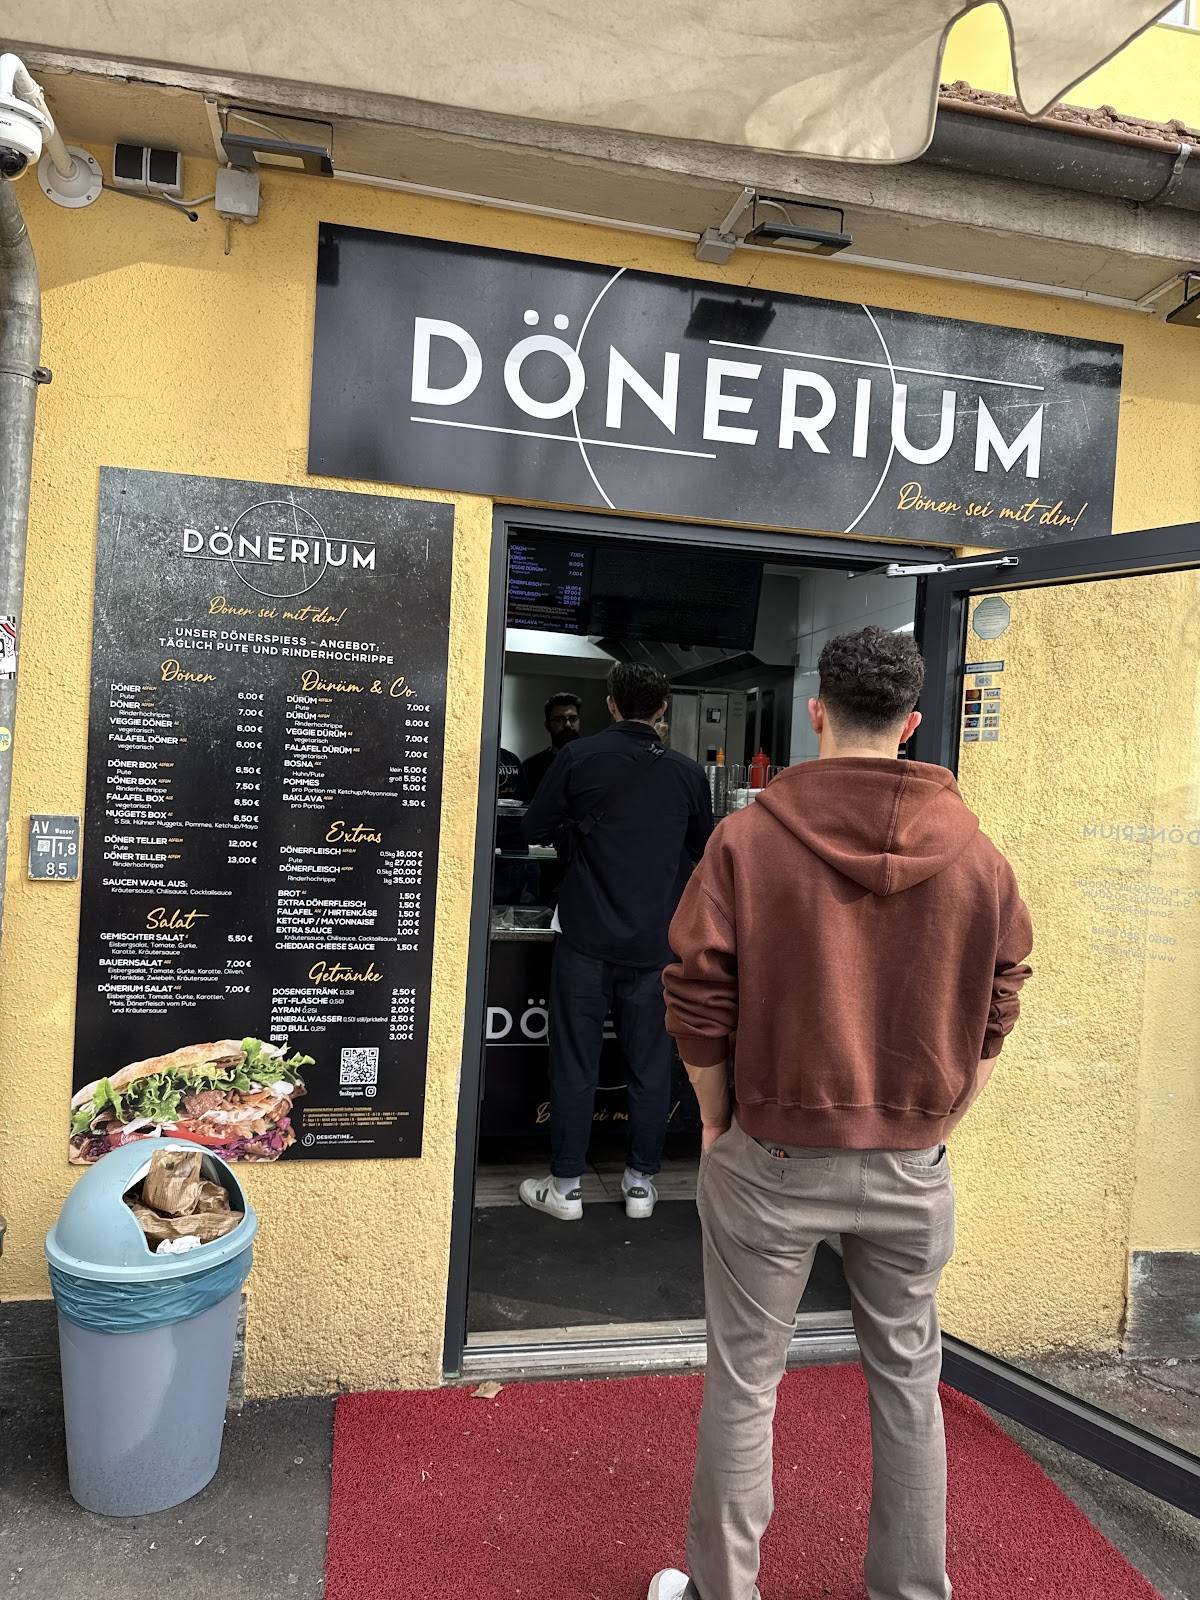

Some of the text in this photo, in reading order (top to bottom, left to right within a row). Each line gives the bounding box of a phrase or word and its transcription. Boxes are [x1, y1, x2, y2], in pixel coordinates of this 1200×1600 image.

[410, 308, 1046, 479] DÖNERIUM
[897, 482, 1088, 531] Döner sei mit dir!
[183, 525, 376, 570] DÖNERIUM
[208, 596, 348, 626] Döner sei mit dir!
[175, 627, 217, 640] UNSER
[221, 629, 308, 646] DÖNERSPIESS
[320, 639, 380, 652] ANGEBOT:
[159, 636, 394, 664] TÄGLICH PUTE UND RINDERHOCHRIPPE
[160, 659, 216, 683] Döner
[111, 683, 141, 693] DÖNER
[301, 669, 418, 698] Dürüm & Co.
[110, 700, 140, 709] DÖNER
[286, 695, 317, 704] DÜRÜM
[119, 710, 170, 718] Rinderhochrippe
[286, 711, 316, 720] DÜRÜM
[110, 717, 141, 726] VEGGIE
[142, 718, 173, 727] DÖNER
[285, 728, 316, 736] VEGGIE
[317, 728, 347, 738] DÜRÜM
[109, 734, 147, 743] FALAFEL
[148, 735, 178, 744] DÖNER
[118, 743, 154, 751] vegetarisch
[285, 744, 321, 753] FALAFEL
[322, 745, 352, 754] DÜRÜM
[107, 759, 138, 768] DÖNER
[139, 761, 158, 769] BOX
[284, 760, 314, 768] BOSNA
[107, 776, 137, 785] DÖNER
[283, 778, 320, 786] POMMES
[106, 793, 144, 802] FALAFEL
[146, 794, 165, 802] BOX
[282, 794, 323, 802] BAKLAVA
[303, 802, 325, 810] Portion
[106, 809, 146, 819] NUGGETS
[148, 811, 167, 819] BOX
[32, 821, 50, 834] AV
[325, 820, 382, 844] Extras
[104, 835, 134, 844] DÖNER
[136, 836, 167, 845] TELLER
[57, 842, 77, 857] 1,8
[280, 845, 341, 856] DÖNERFLEISCH
[103, 851, 134, 860] DÖNER
[135, 853, 167, 861] TELLER
[46, 862, 67, 878] 8,5
[112, 861, 164, 869] Rinderhochrippe
[279, 864, 340, 873] DÖNERFLEISCH
[102, 878, 188, 888] SAUCEN WAHL AUS:
[306, 898, 366, 908] DÖNERFLEISCH
[277, 908, 313, 916] FALAFEL
[328, 908, 378, 917] HIRTENKÄSE
[146, 907, 210, 930] Salat
[276, 917, 314, 925] KETCHUP
[321, 918, 375, 926] MAYONNAISE
[100, 932, 155, 941] GEMISCHTER
[156, 933, 184, 941] SALAT
[275, 942, 314, 950] CHEDDAR
[348, 943, 375, 951] SAUCE
[99, 959, 163, 967] BAUERNSALAT
[309, 961, 384, 985] Getränke
[98, 984, 144, 992] DÖNERIUM
[272, 987, 339, 996] DOSENGETRÄNK
[271, 997, 328, 1005] PET-FLASCHE
[271, 1006, 301, 1014] AYRAN
[271, 1015, 342, 1023] MINERALWASSER
[270, 1024, 309, 1032] RED BULL
